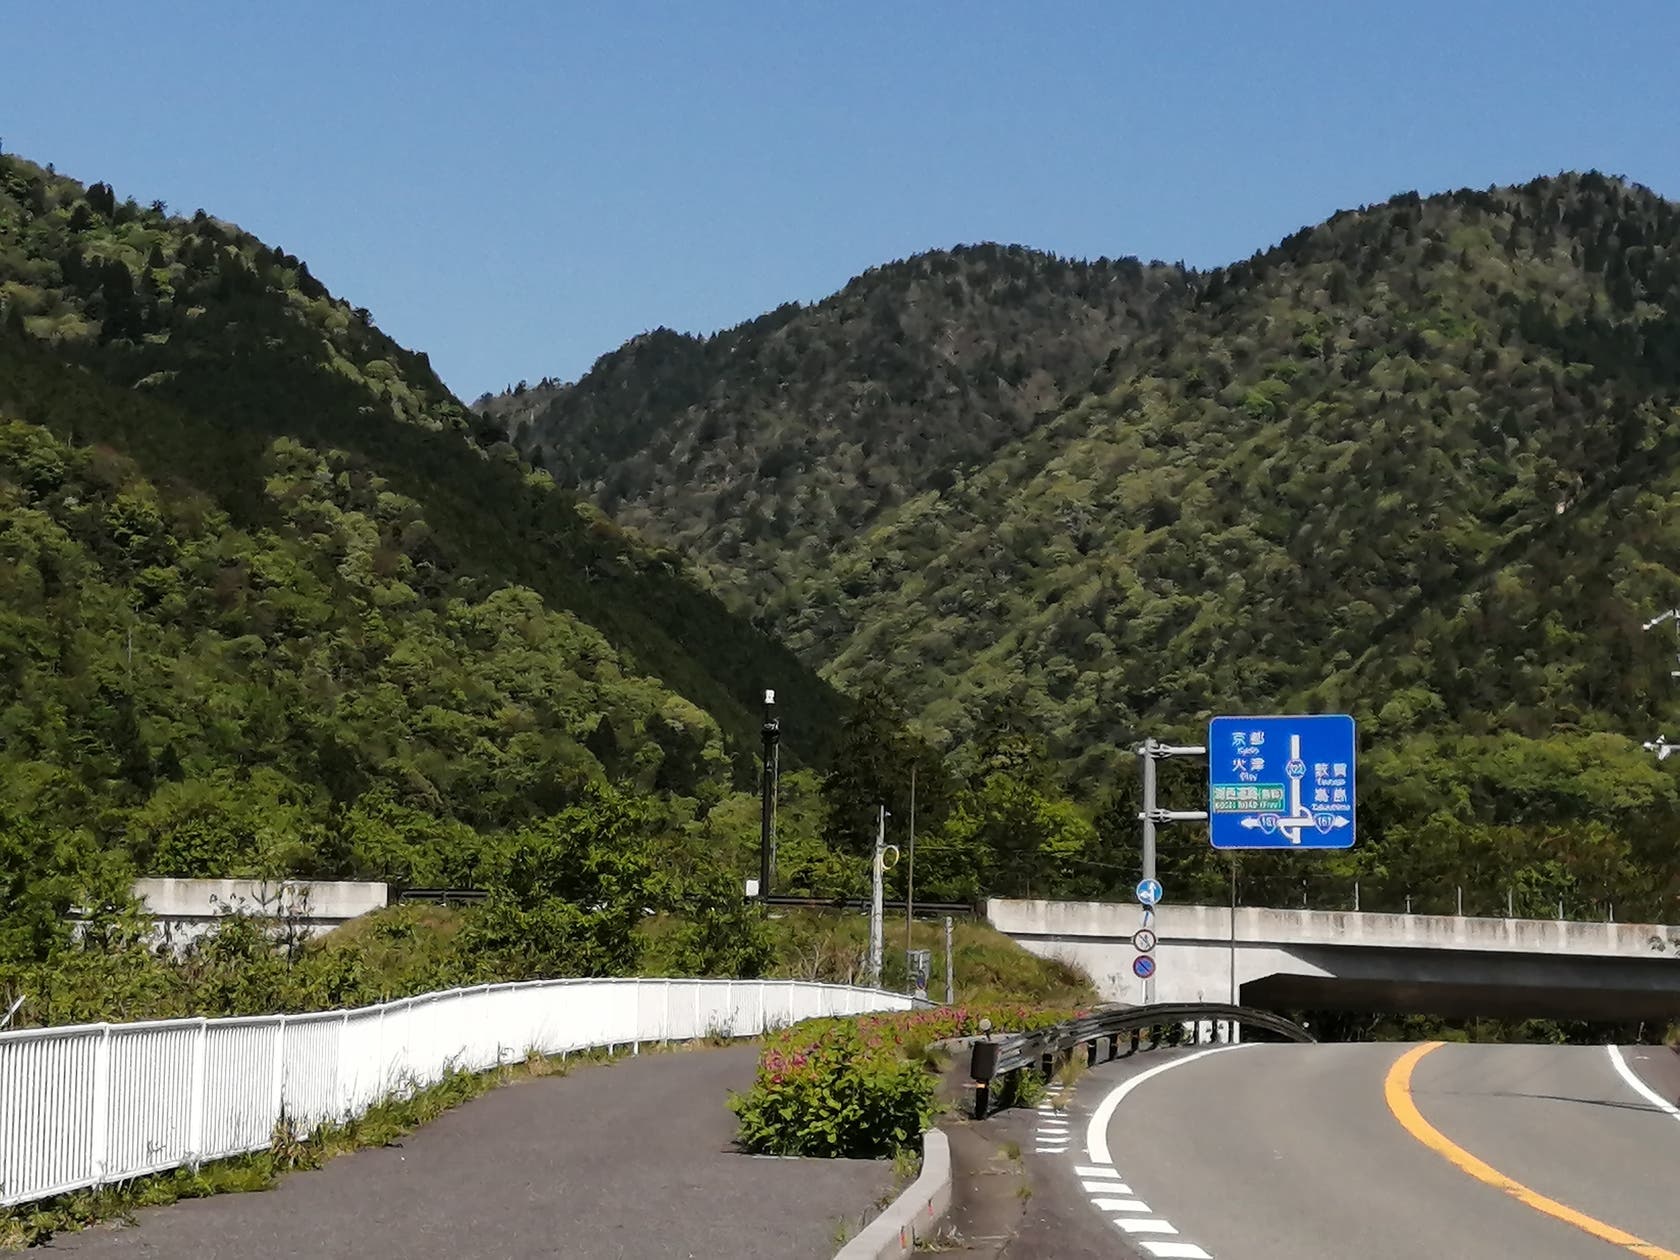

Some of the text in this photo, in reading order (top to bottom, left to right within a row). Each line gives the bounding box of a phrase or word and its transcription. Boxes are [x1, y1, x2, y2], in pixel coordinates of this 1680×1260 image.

[1232, 731, 1265, 746] 京都
[1314, 763, 1347, 778] 敦賀
[1314, 788, 1347, 802] 高島
[1318, 817, 1332, 827] 161
